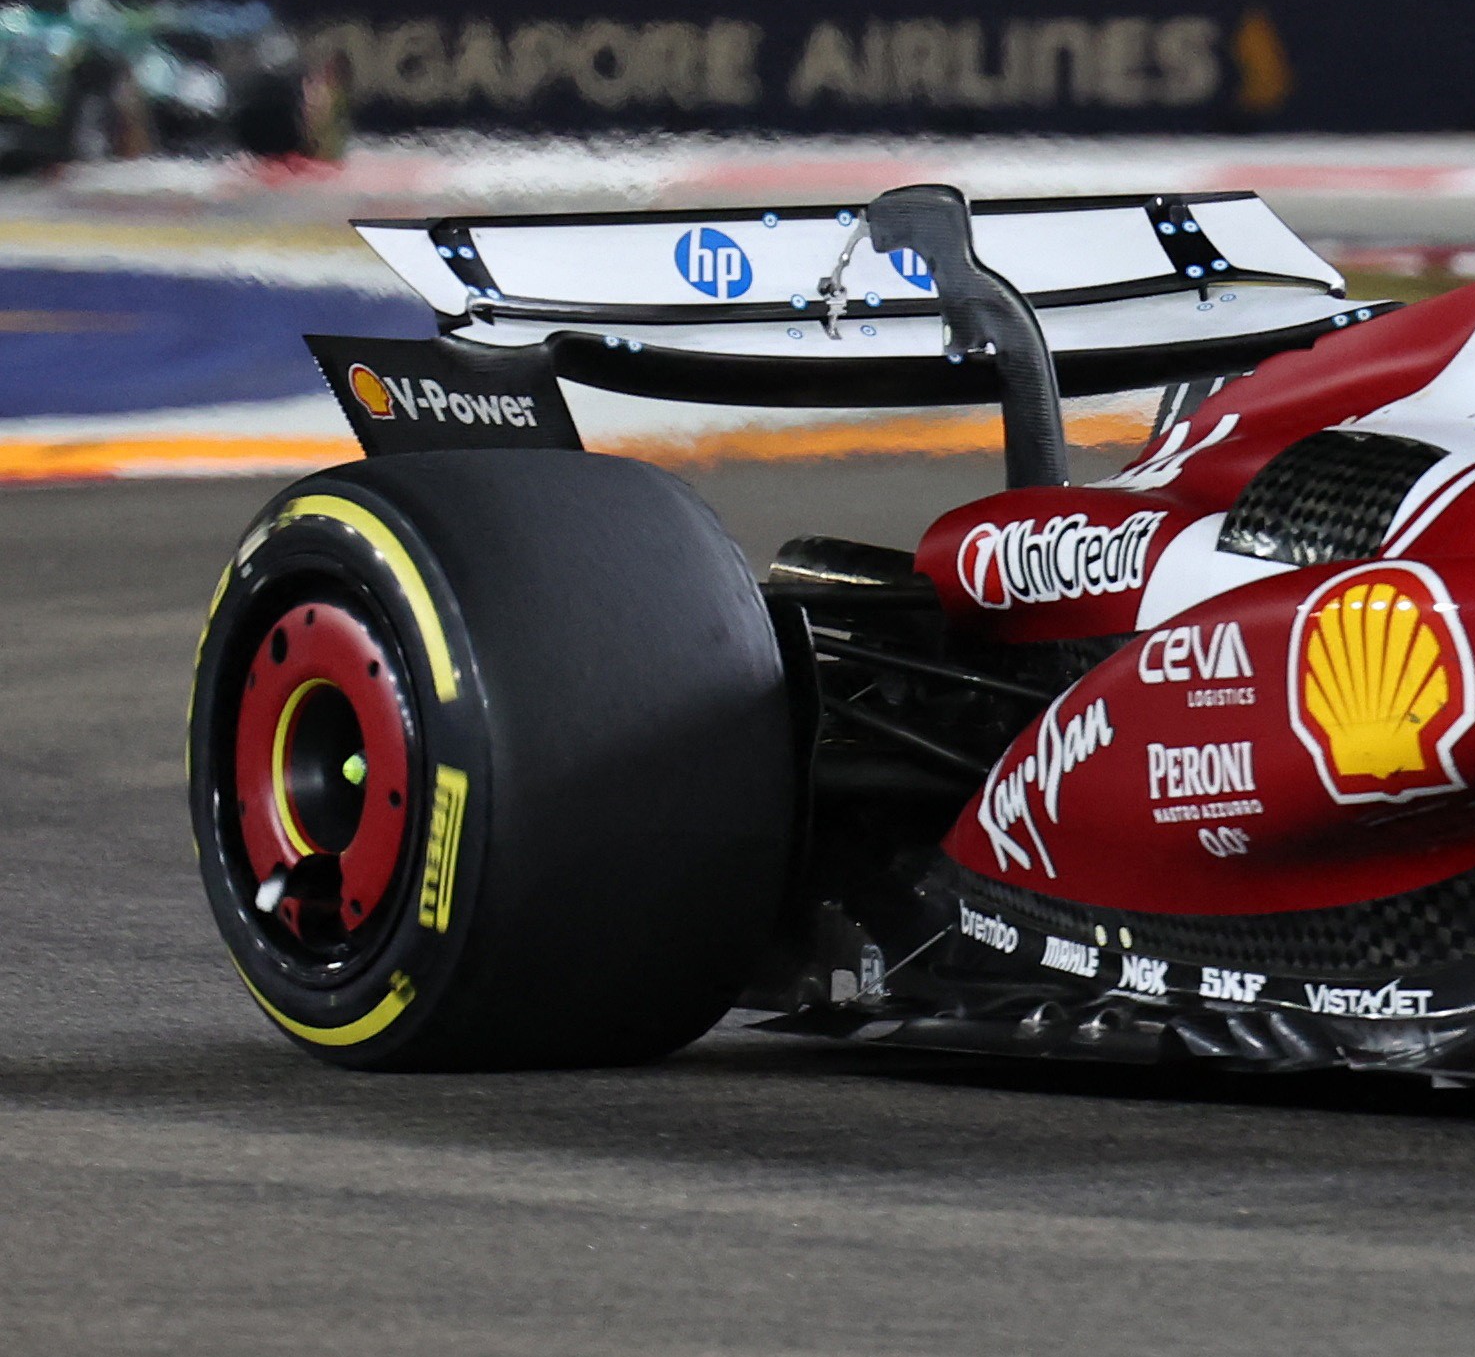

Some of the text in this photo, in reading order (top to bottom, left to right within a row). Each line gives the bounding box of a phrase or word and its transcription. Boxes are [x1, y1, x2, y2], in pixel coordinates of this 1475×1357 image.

[788, 14, 1222, 109] AIRLINES
[687, 227, 744, 300] hp
[383, 376, 538, 428] V-Power
[1001, 512, 1166, 601] UniCredit
[1187, 687, 1256, 708] LOGISTICS
[1147, 741, 1257, 800] PERONI
[959, 899, 1019, 953] brembo
[1040, 935, 1100, 977] MAHLE
[1117, 954, 1169, 996] NGK
[1200, 966, 1267, 1003] SKF
